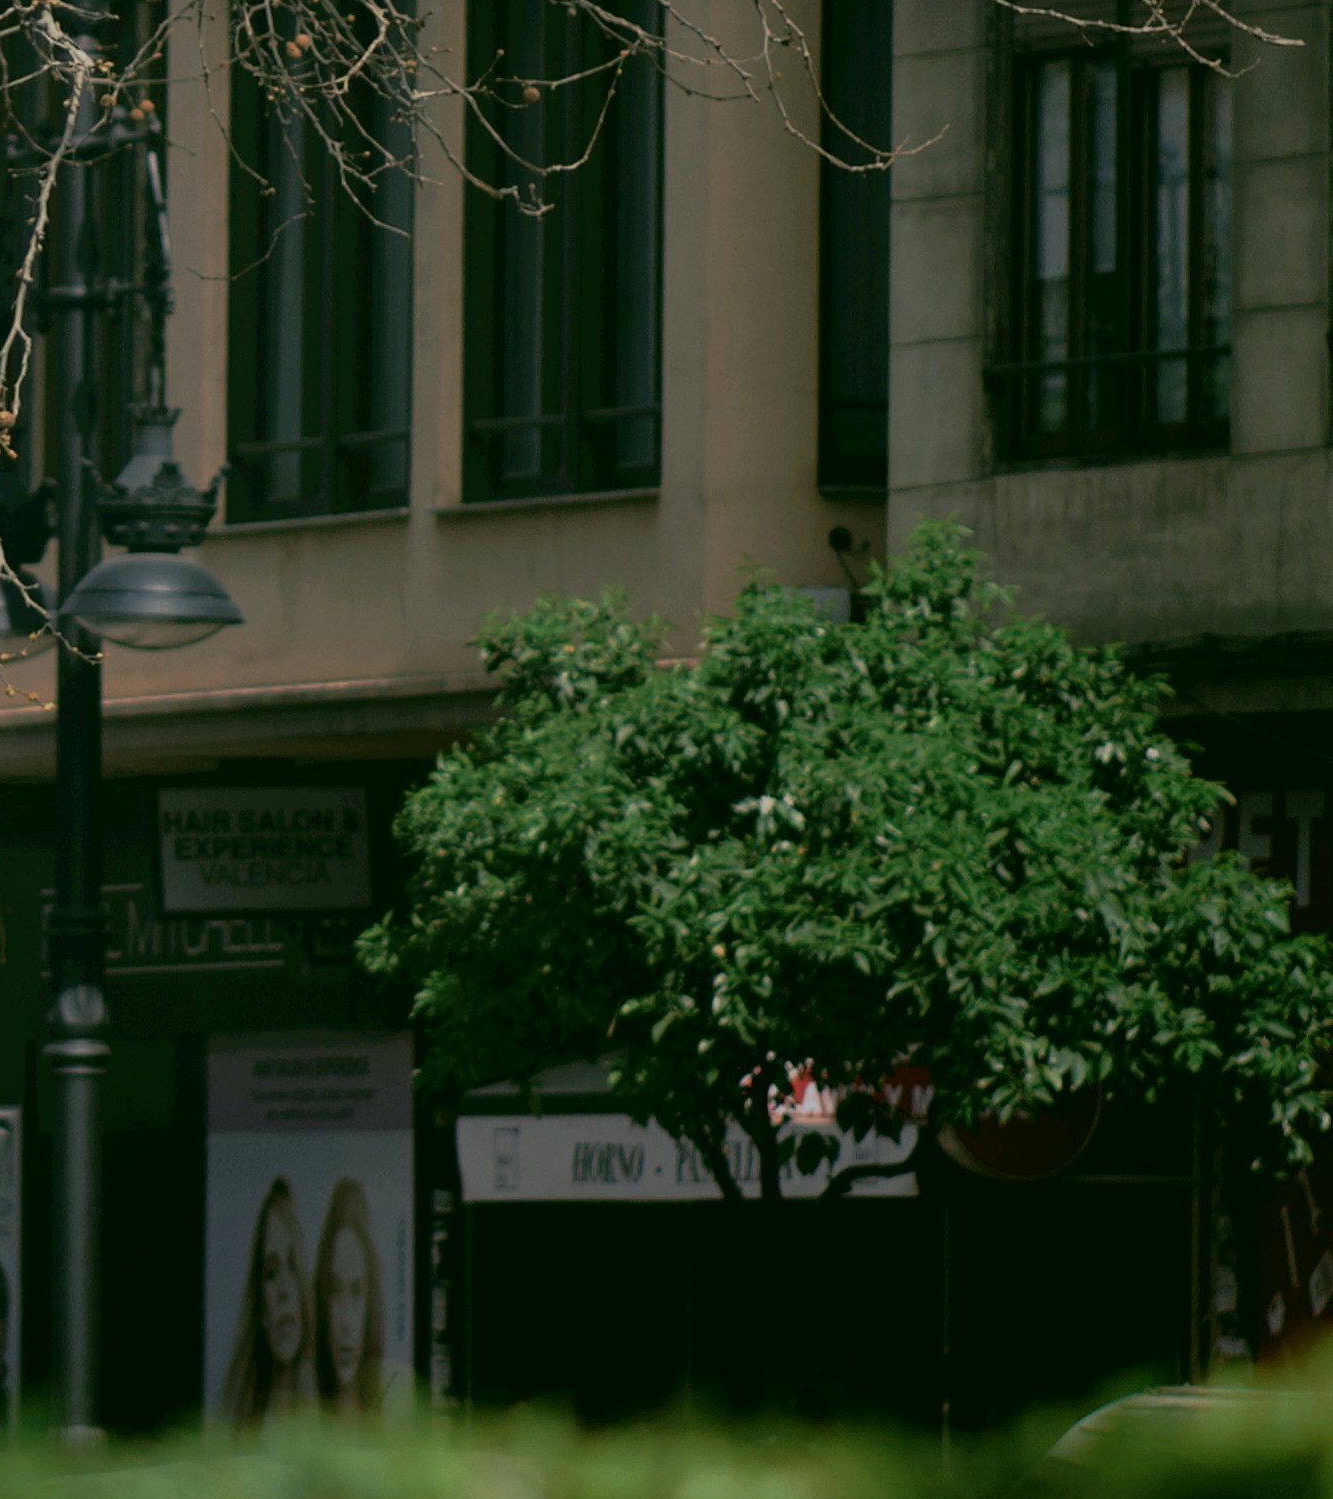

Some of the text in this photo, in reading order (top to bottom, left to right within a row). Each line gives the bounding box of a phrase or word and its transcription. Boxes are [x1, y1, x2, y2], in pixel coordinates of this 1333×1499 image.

[163, 810, 231, 834] HAIR
[237, 808, 335, 833] SALON
[174, 835, 353, 861] EXPERIENCE
[198, 862, 333, 886] VALENCIA
[572, 1141, 644, 1183] HORNO
